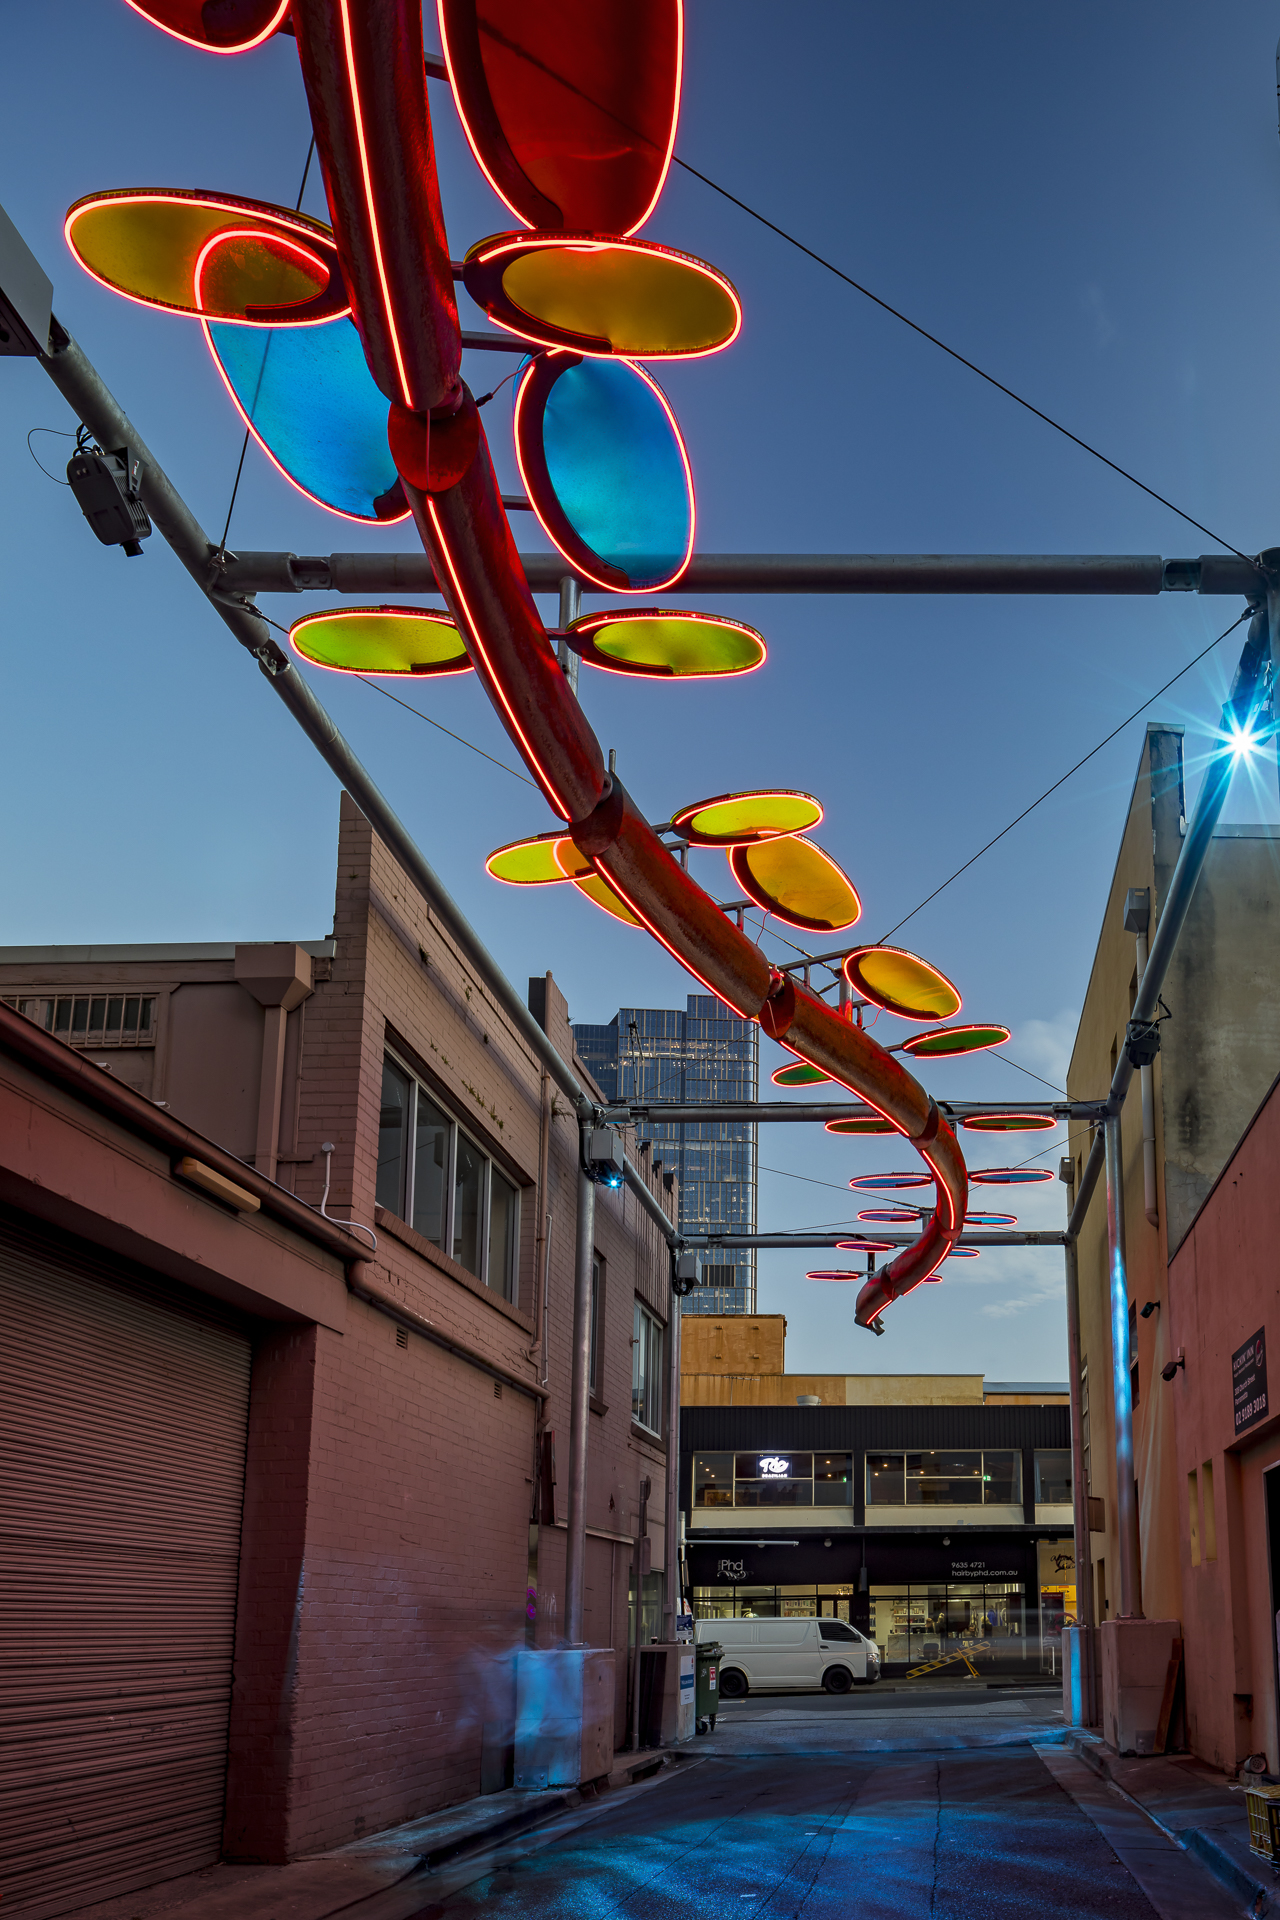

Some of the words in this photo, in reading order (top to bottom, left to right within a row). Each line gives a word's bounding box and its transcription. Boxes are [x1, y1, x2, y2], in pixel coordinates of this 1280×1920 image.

[1247, 1374, 1256, 1385] Street
[1236, 1411, 1241, 1426] 02
[1242, 1402, 1253, 1421] 9189
[1253, 1393, 1266, 1414] 3018
[721, 1559, 744, 1571] Phd
